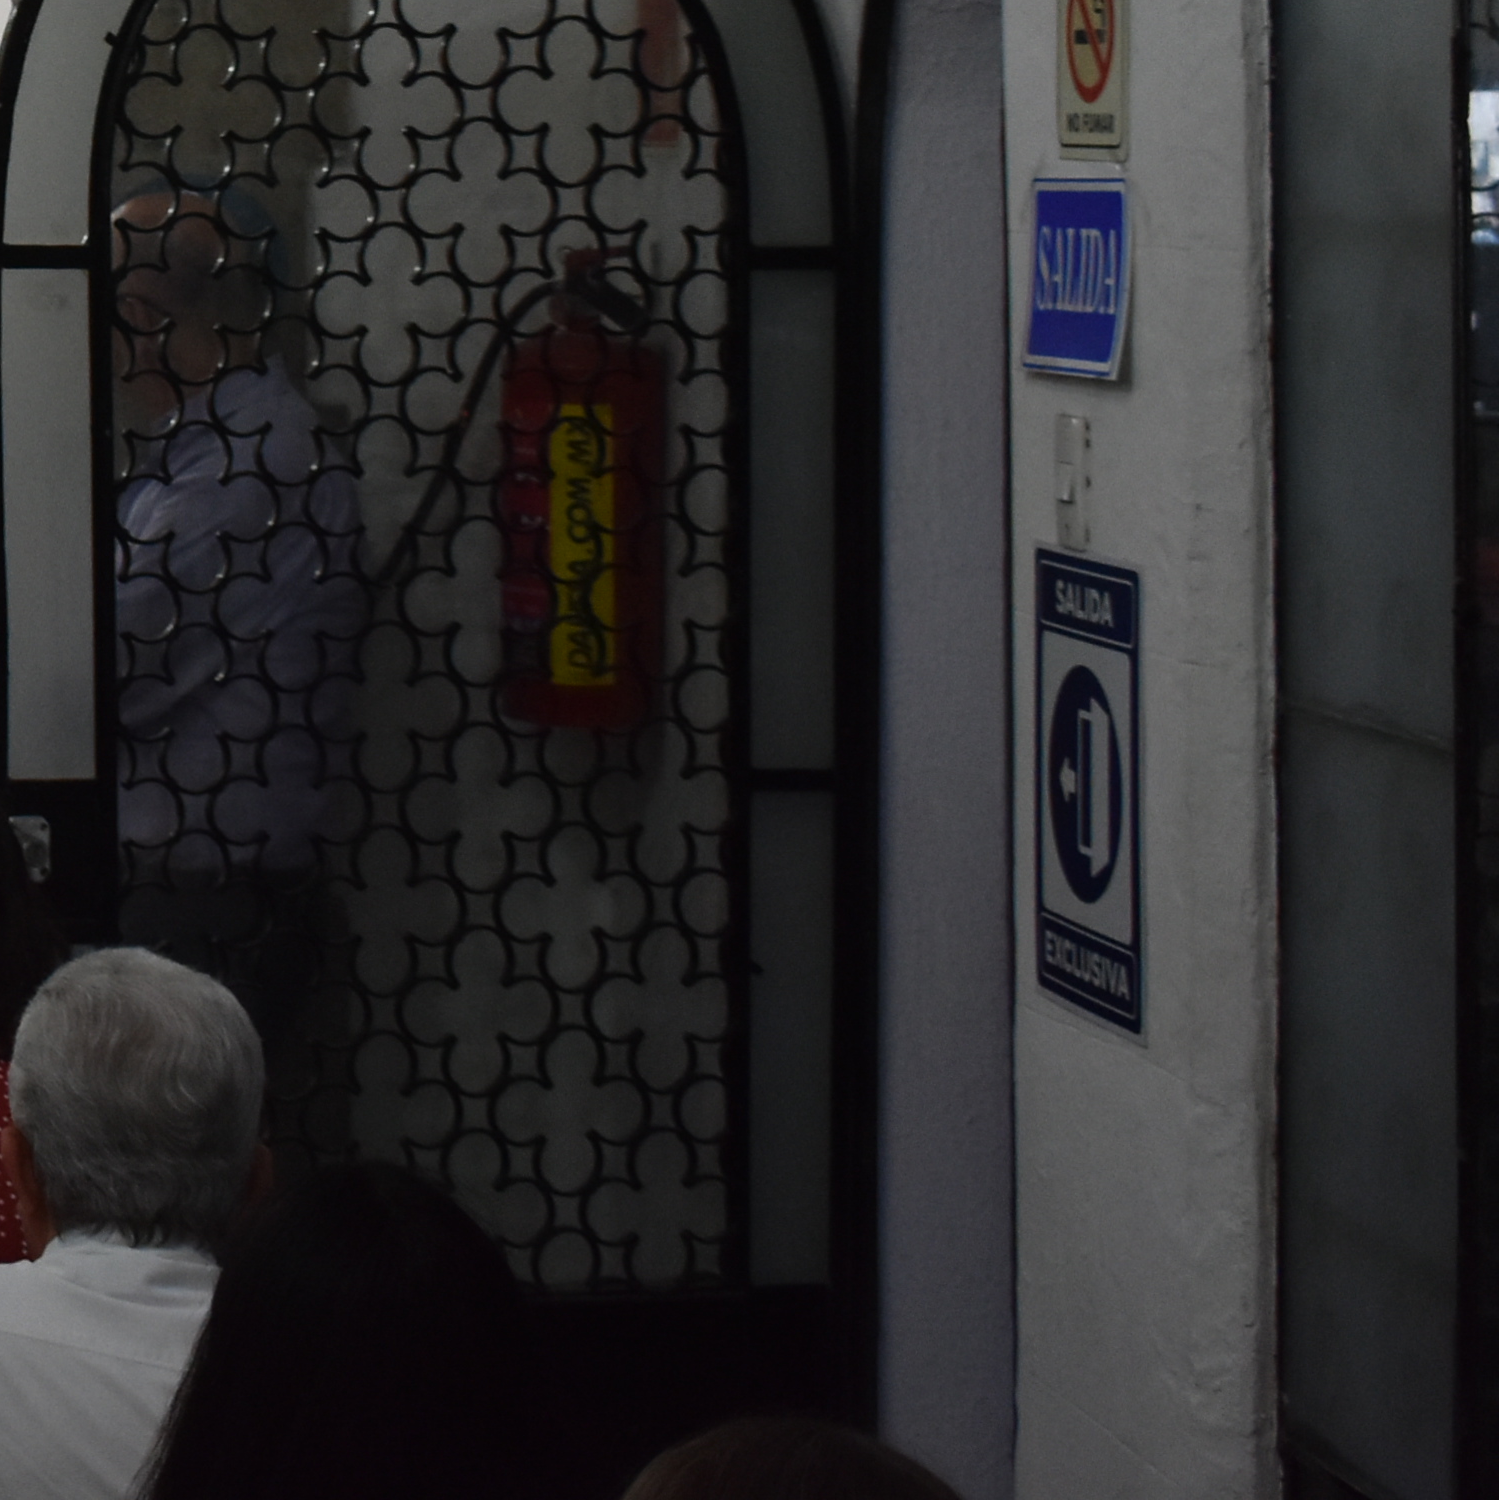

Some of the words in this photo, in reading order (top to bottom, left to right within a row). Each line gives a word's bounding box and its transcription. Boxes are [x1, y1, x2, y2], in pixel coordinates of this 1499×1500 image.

[1035, 226, 1117, 316] SALIDA
[1054, 579, 1114, 630] SALIDA
[1044, 930, 1131, 1001] EXCLUSIVA
